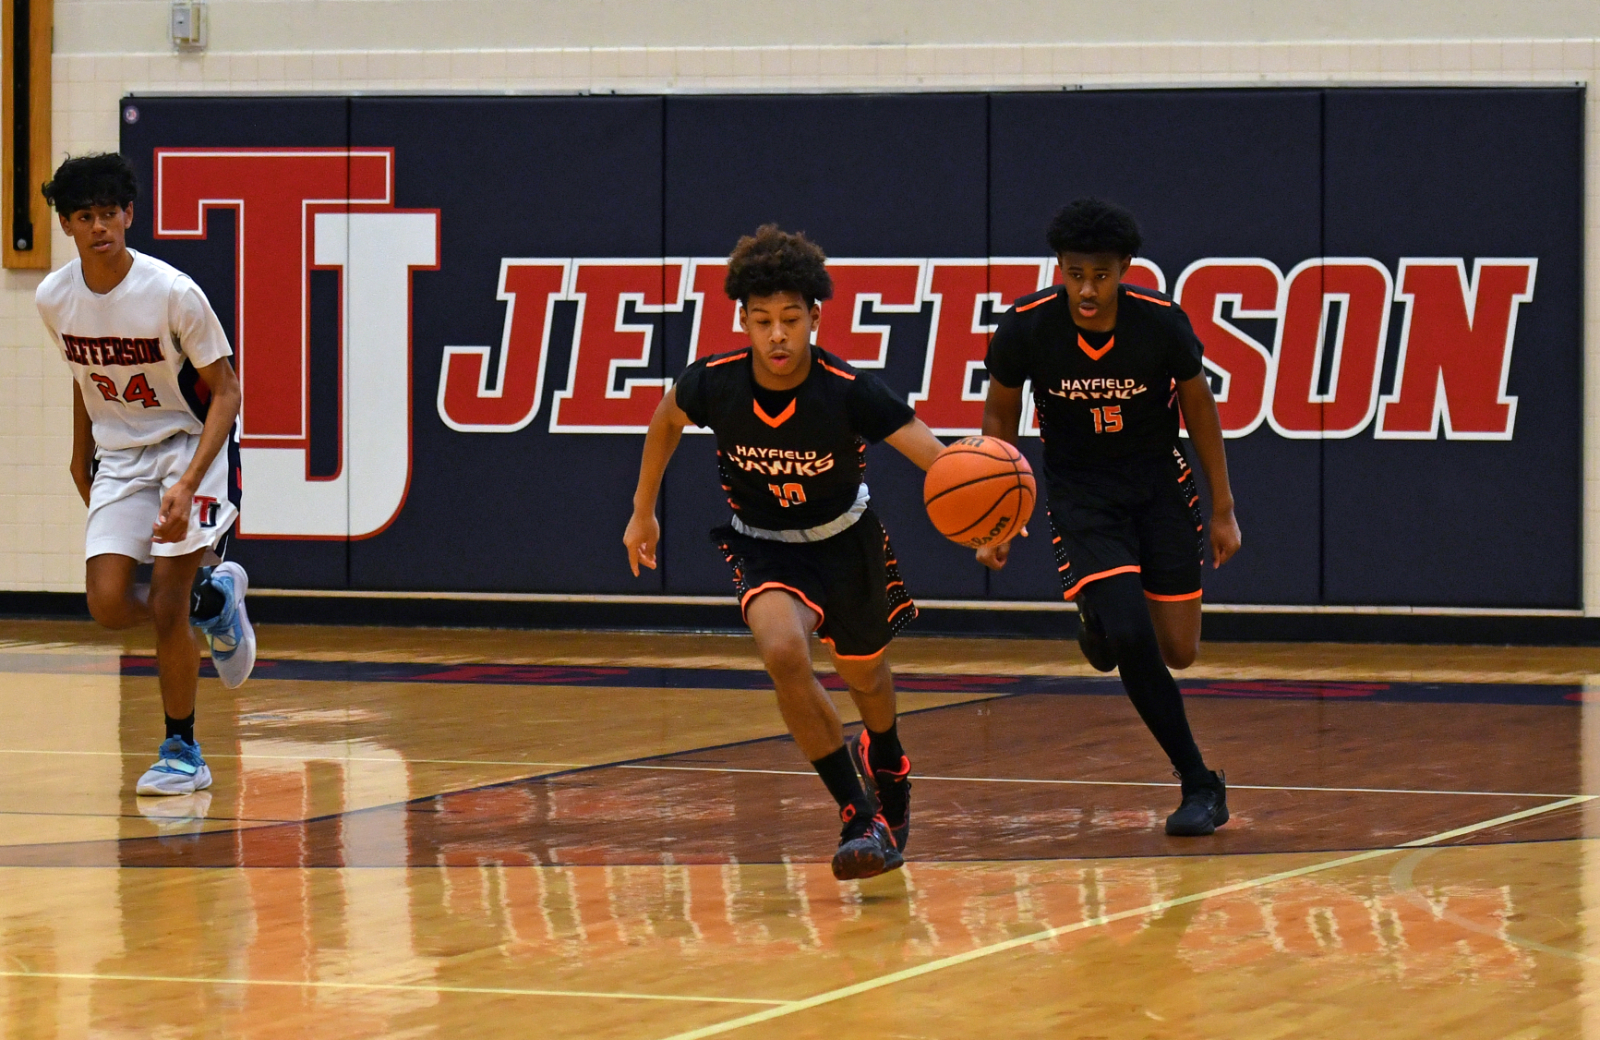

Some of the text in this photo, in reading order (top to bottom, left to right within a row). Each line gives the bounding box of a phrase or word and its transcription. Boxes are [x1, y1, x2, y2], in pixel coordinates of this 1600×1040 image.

[62, 334, 165, 366] JEFFERSON
[154, 147, 440, 539] TJ
[90, 373, 161, 408] 24
[1061, 378, 1135, 390] HAYFIELD
[1090, 405, 1124, 433] 15
[736, 445, 817, 460] HAYFIELD
[768, 482, 807, 508] 10
